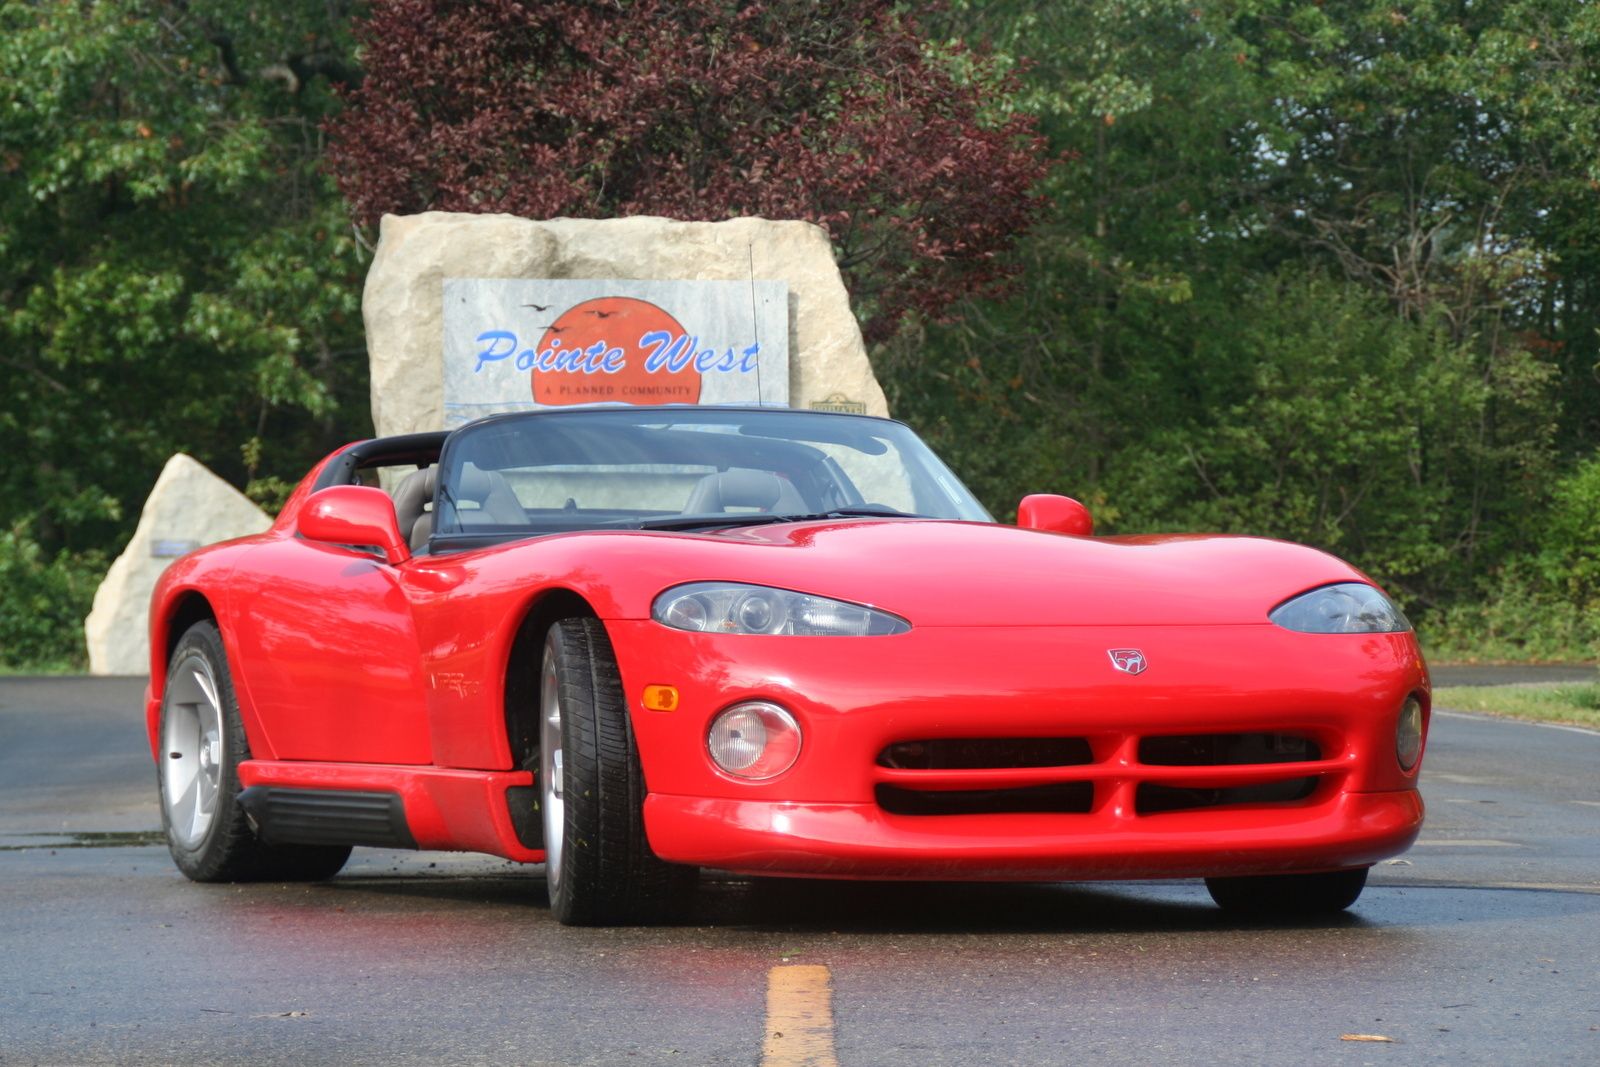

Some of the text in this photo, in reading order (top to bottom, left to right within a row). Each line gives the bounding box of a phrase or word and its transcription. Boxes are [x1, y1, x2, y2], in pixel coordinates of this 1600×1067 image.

[474, 329, 762, 374] Pointe West
[544, 385, 692, 396] A PLANNED COMMUNITY
